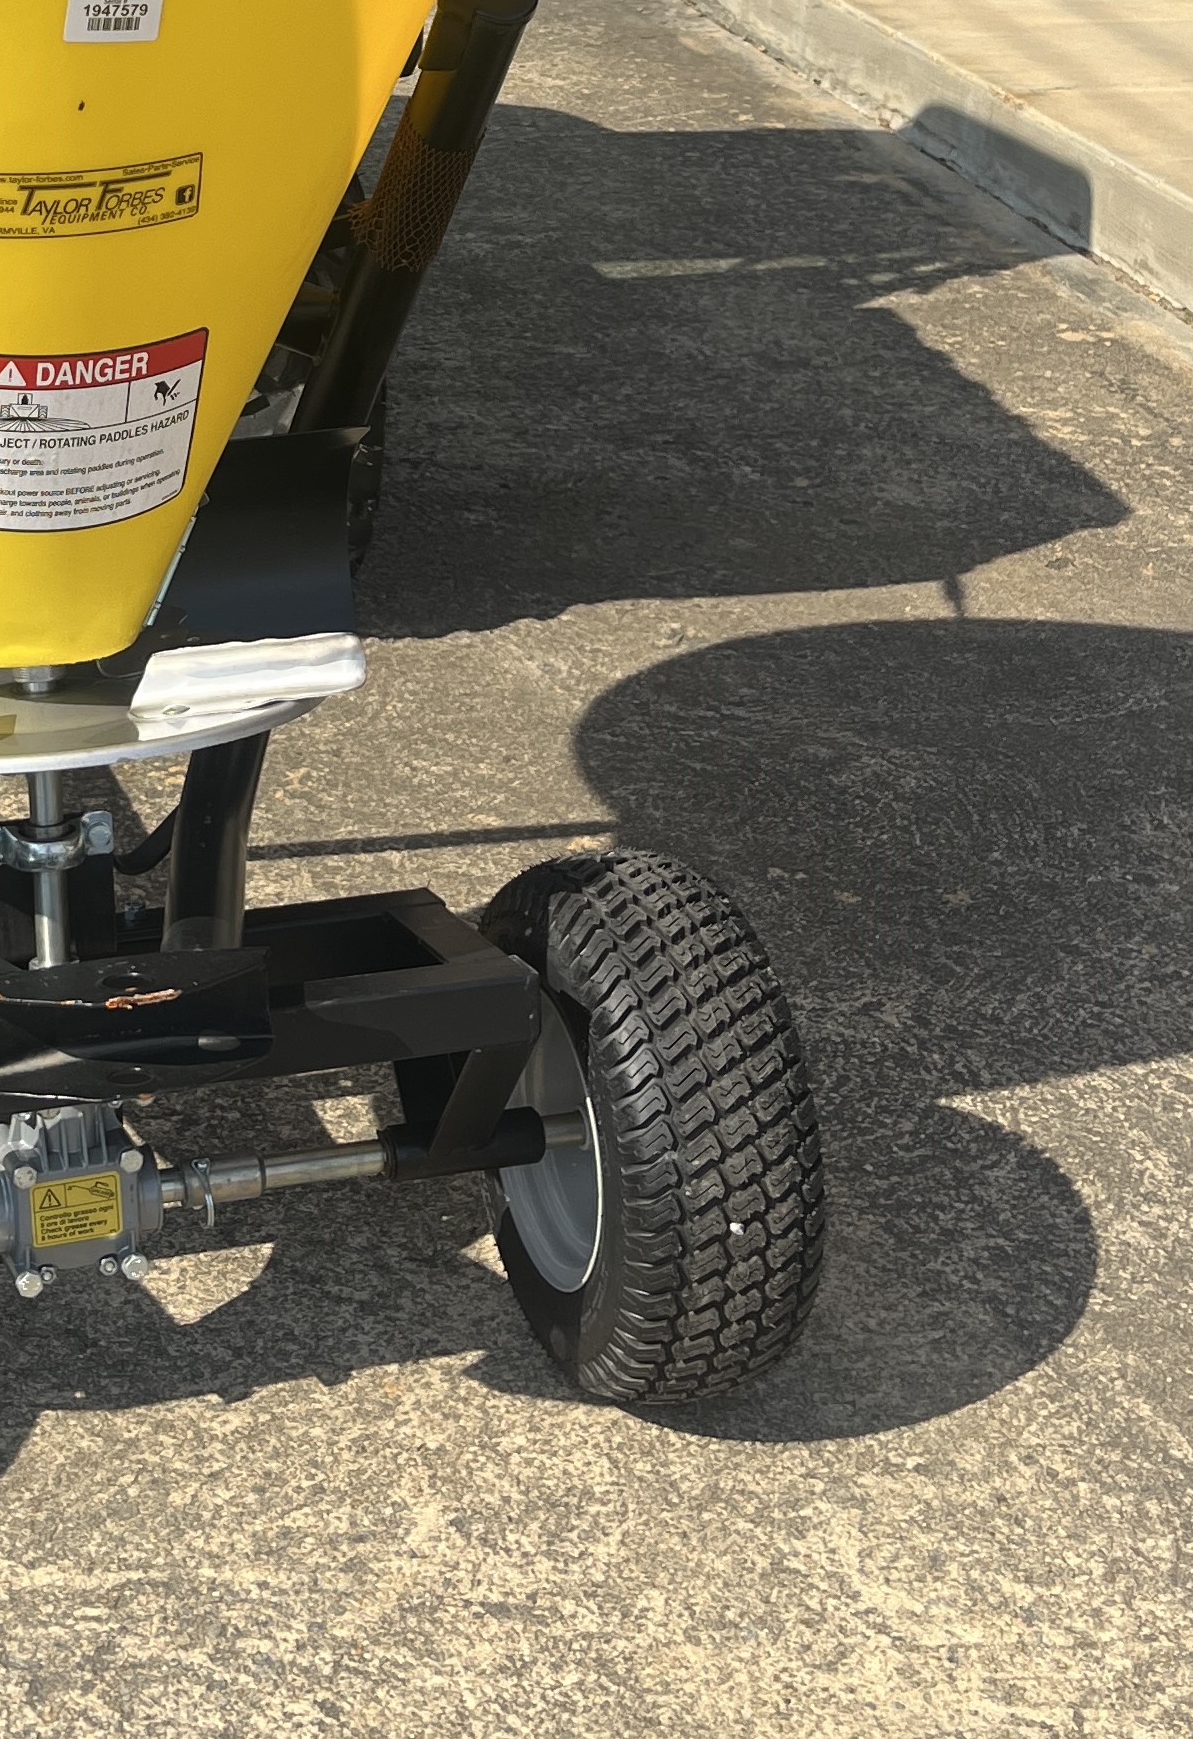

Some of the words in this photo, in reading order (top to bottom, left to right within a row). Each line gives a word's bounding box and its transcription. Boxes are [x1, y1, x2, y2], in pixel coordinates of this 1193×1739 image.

[83, 3, 149, 17] 1947579
[17, 181, 97, 226] TAYLOR
[95, 170, 172, 211] FORBES
[49, 209, 126, 225] EQUIPMENT
[42, 226, 56, 234] VA
[35, 351, 150, 388] DANGER
[39, 434, 96, 449] ROTATING
[99, 425, 149, 444] PADDLES
[150, 409, 190, 433] HAZARD
[45, 468, 58, 476] and
[60, 466, 87, 476] rotating
[114, 458, 135, 469] during
[17, 490, 39, 499] power
[65, 485, 95, 495] BEFORE
[96, 479, 126, 492] adjusting
[10, 509, 24, 517] and
